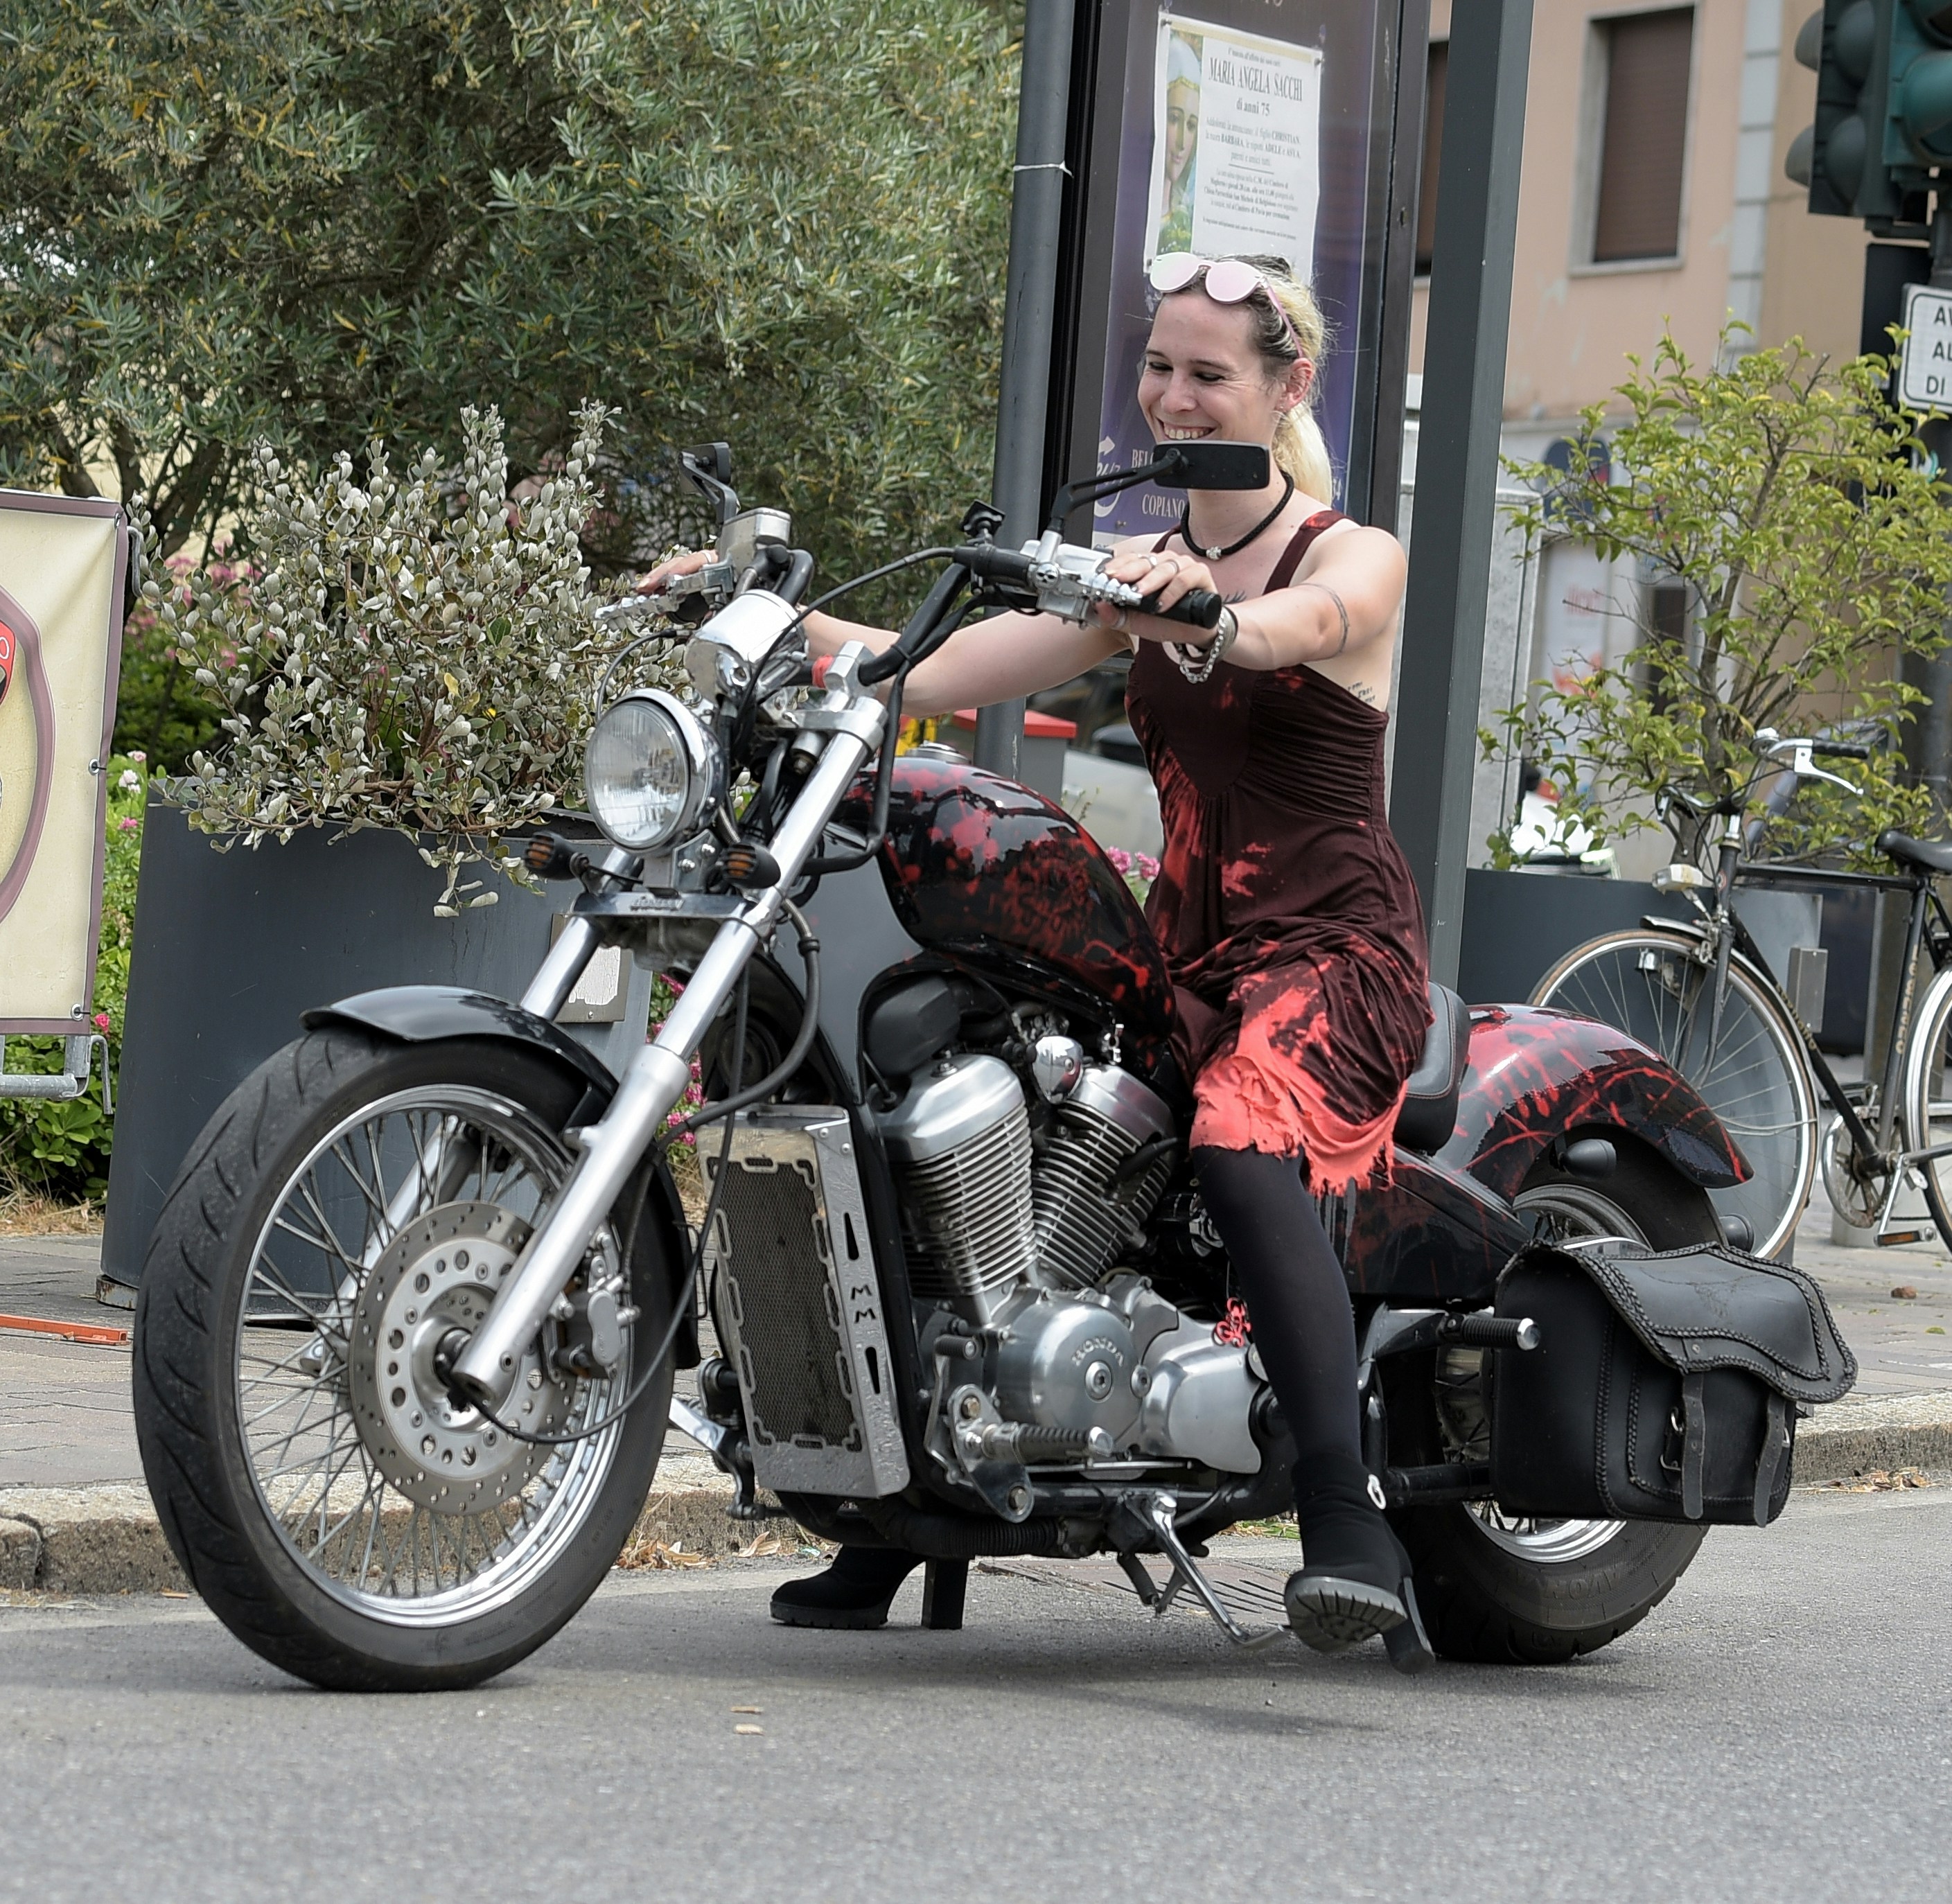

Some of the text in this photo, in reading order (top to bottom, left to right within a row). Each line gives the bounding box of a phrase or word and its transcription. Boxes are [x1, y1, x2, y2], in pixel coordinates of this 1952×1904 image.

[1209, 57, 1235, 86] MARIA
[1238, 65, 1270, 94] ANGELA
[1274, 73, 1303, 101] SACCHI
[1236, 97, 1270, 116] di anni 75
[1926, 375, 1945, 396] DI
[1142, 493, 1186, 520] COPIANO
[1071, 1335, 1125, 1368] HONDA
